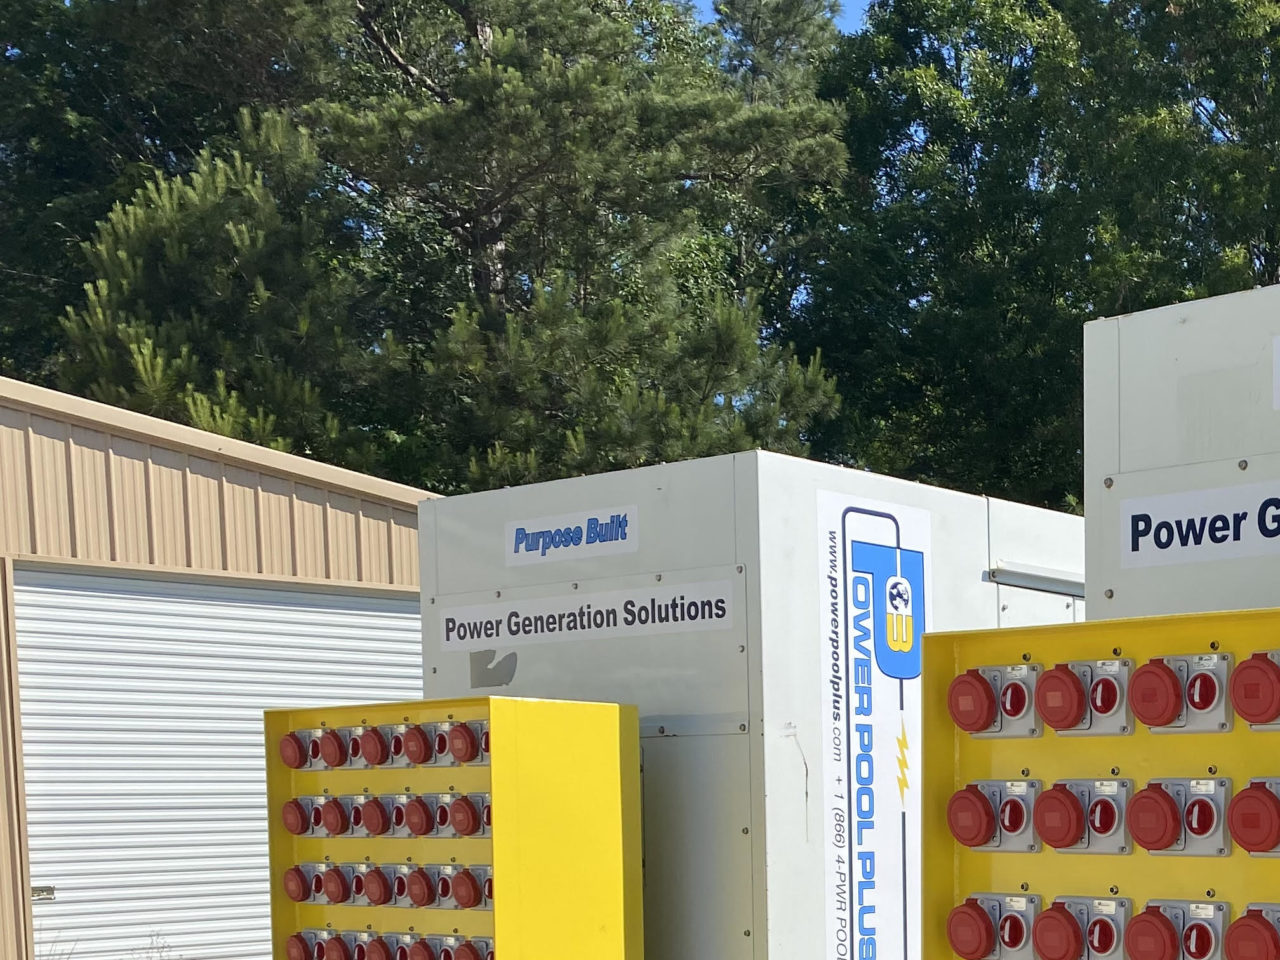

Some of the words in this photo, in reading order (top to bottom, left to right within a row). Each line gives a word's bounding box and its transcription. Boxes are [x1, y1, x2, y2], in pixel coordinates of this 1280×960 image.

[513, 526, 583, 557] Purpose
[586, 513, 628, 544] Built
[1130, 510, 1249, 552] Power
[445, 616, 502, 642] Power
[507, 604, 617, 637] Generation
[623, 595, 727, 626] Solutions
[851, 540, 925, 717] POWER
[827, 529, 842, 762] www.powerpoolplus.com
[855, 724, 875, 846] POOL
[832, 806, 846, 849] (866)
[834, 854, 847, 912] 4-PWR
